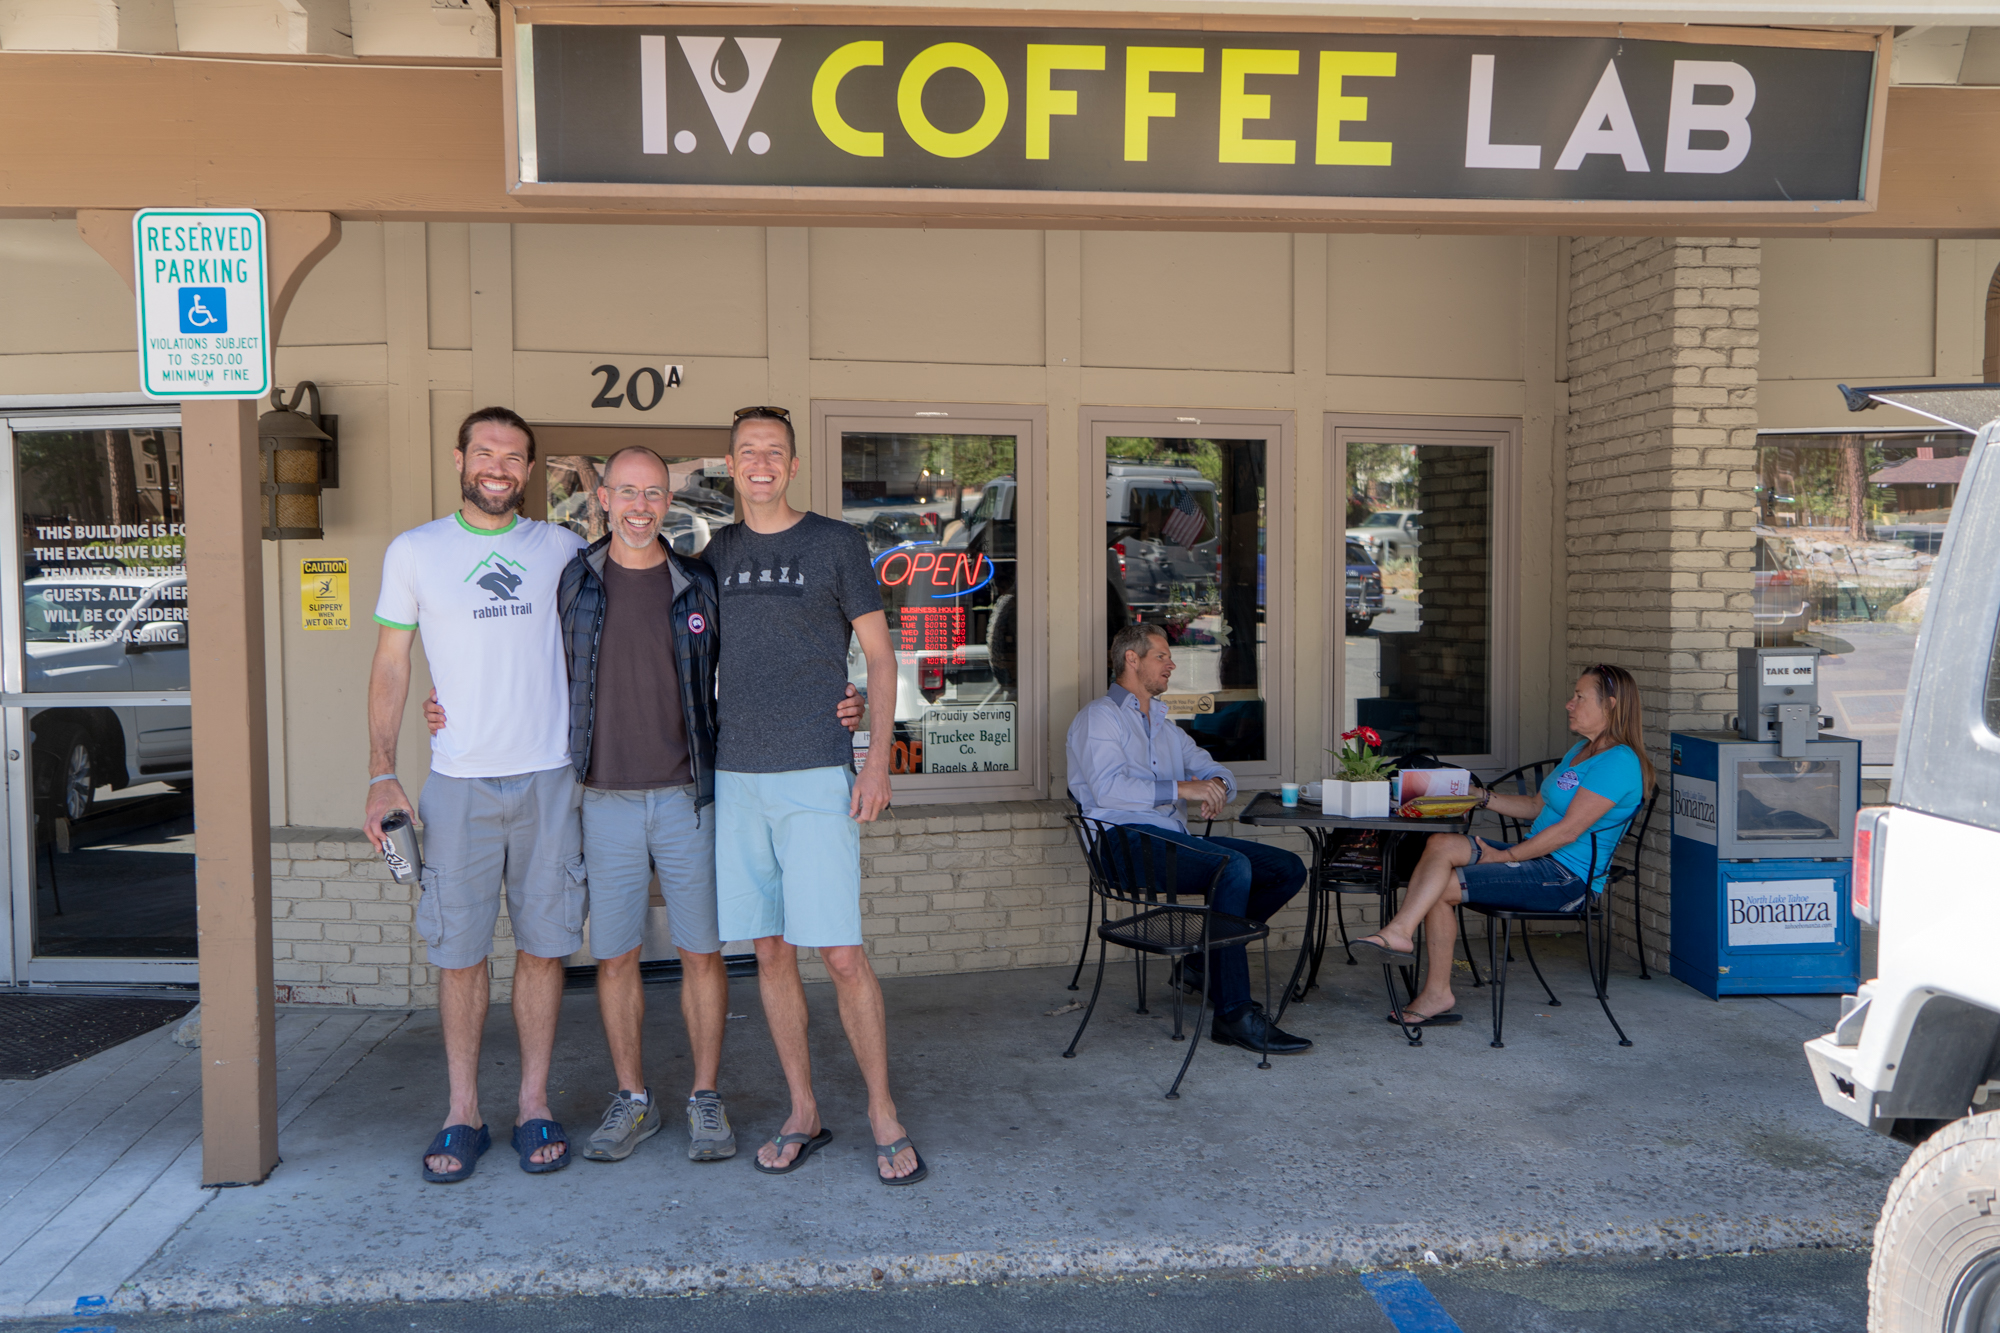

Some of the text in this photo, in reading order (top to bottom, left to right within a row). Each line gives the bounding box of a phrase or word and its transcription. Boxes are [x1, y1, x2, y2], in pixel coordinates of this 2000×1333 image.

[640, 35, 1756, 174] I.V. COFFEE LAB
[147, 226, 252, 252] RESERVED
[155, 258, 248, 284] PARKING
[150, 337, 259, 350] VIOLATIONS SUBJECT
[168, 353, 243, 366] TO $250.00
[162, 369, 250, 381] MINIMUM FINE
[36, 526, 72, 540] THIS
[74, 524, 149, 539] BUILDING
[152, 524, 167, 538] IS
[33, 547, 64, 561] THE
[66, 545, 149, 560] EXCLUSIVE
[151, 544, 182, 559] USE
[41, 565, 187, 581] TENANTS AND THEI
[304, 562, 346, 573] CAUTION
[881, 552, 983, 586] OPEN
[42, 588, 106, 602] GUESTS.
[108, 587, 137, 601] ALL
[43, 607, 189, 623] WILL BE CONSIDERE
[308, 604, 343, 612] SLIPPERY
[472, 602, 533, 620] rabbit trail
[335, 618, 347, 626] ICY
[66, 628, 179, 643] TRESSPASSING
[1765, 667, 1812, 675] TAKE ONE
[930, 709, 1011, 723] Proudly Serving
[928, 728, 1011, 746] Truckee Bagel
[959, 744, 977, 755] Co.
[932, 761, 1009, 774] Bagels & More
[1674, 789, 1716, 824] Bonanza
[1746, 893, 1810, 905] North Lake Tahoe
[1729, 898, 1831, 925] Bonanza
